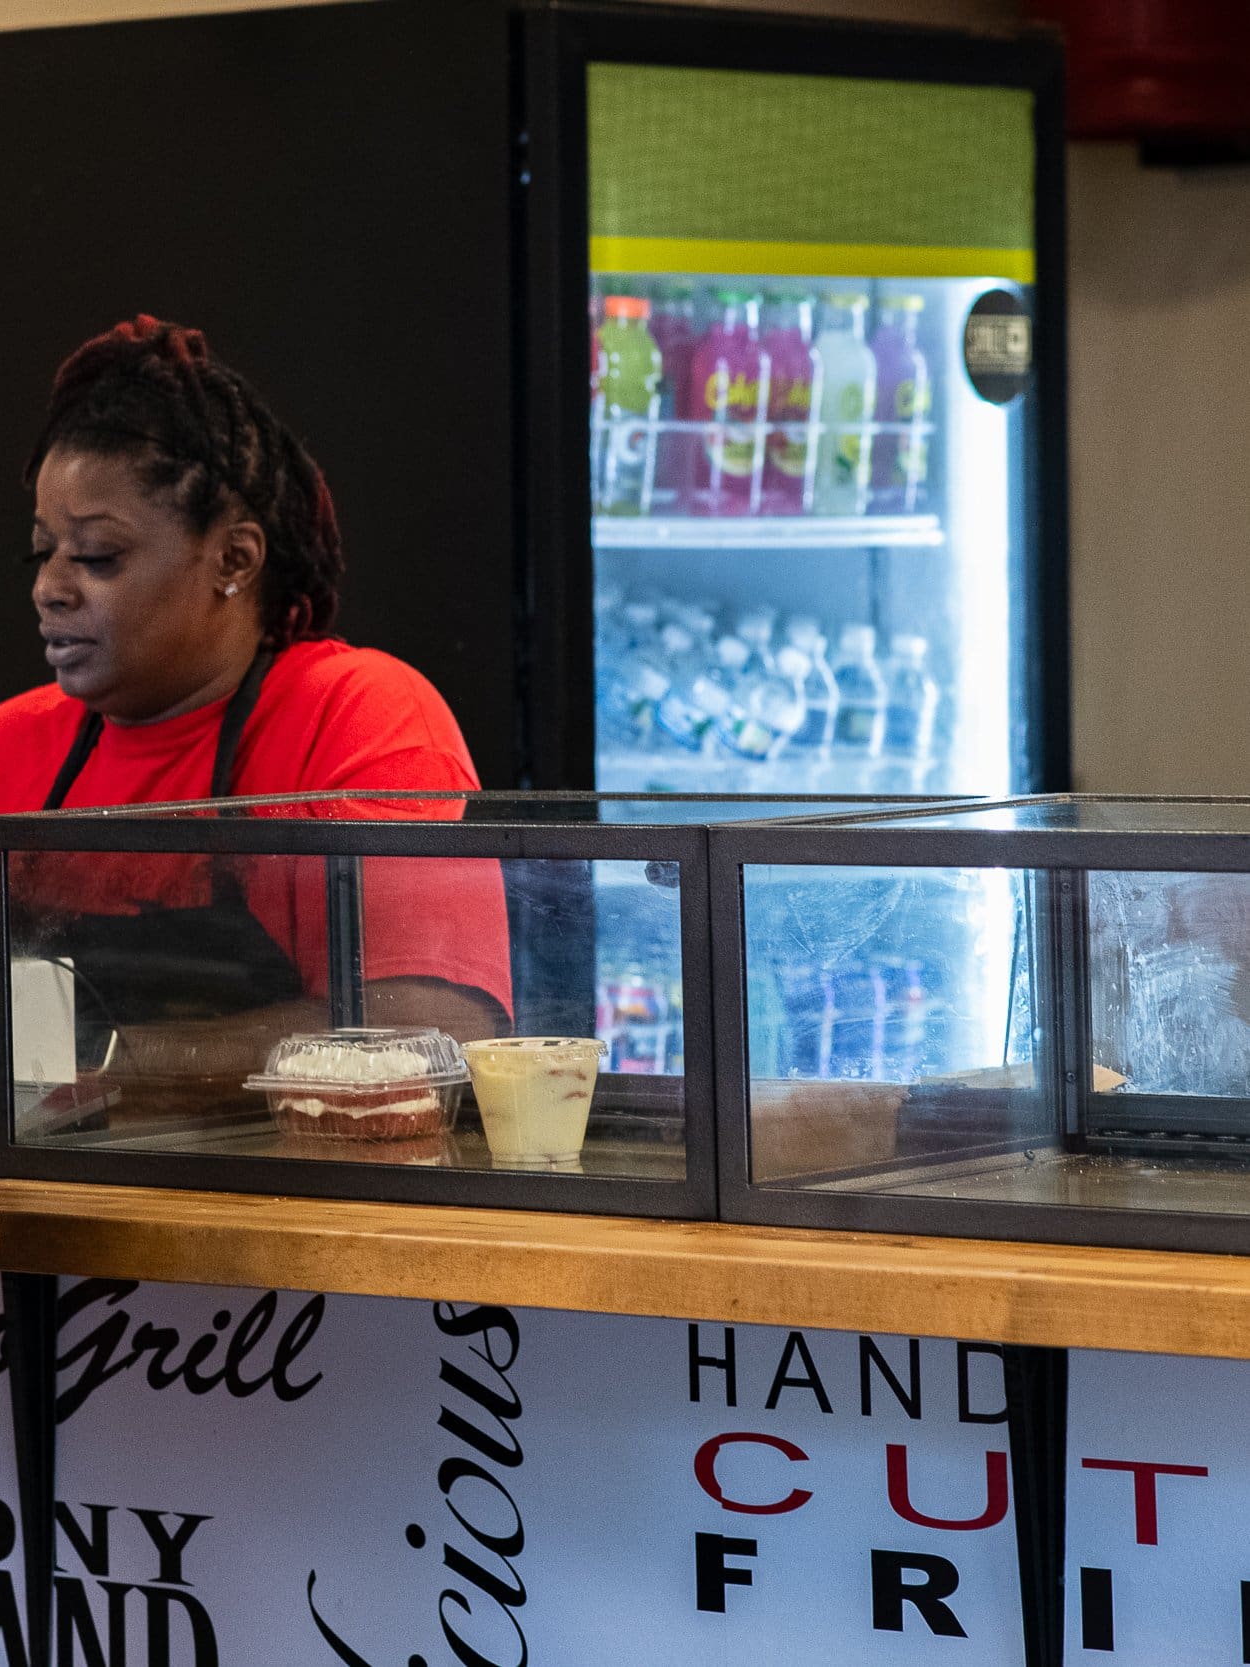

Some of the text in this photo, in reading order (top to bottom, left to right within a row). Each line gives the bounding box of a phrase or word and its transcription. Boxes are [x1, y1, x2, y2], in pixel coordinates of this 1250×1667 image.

[54, 1277, 326, 1426] Grill
[687, 1323, 1010, 1425] HAND
[306, 1302, 530, 1667] cious
[693, 1432, 1209, 1546] CUT
[694, 1531, 1250, 1665] FRI
